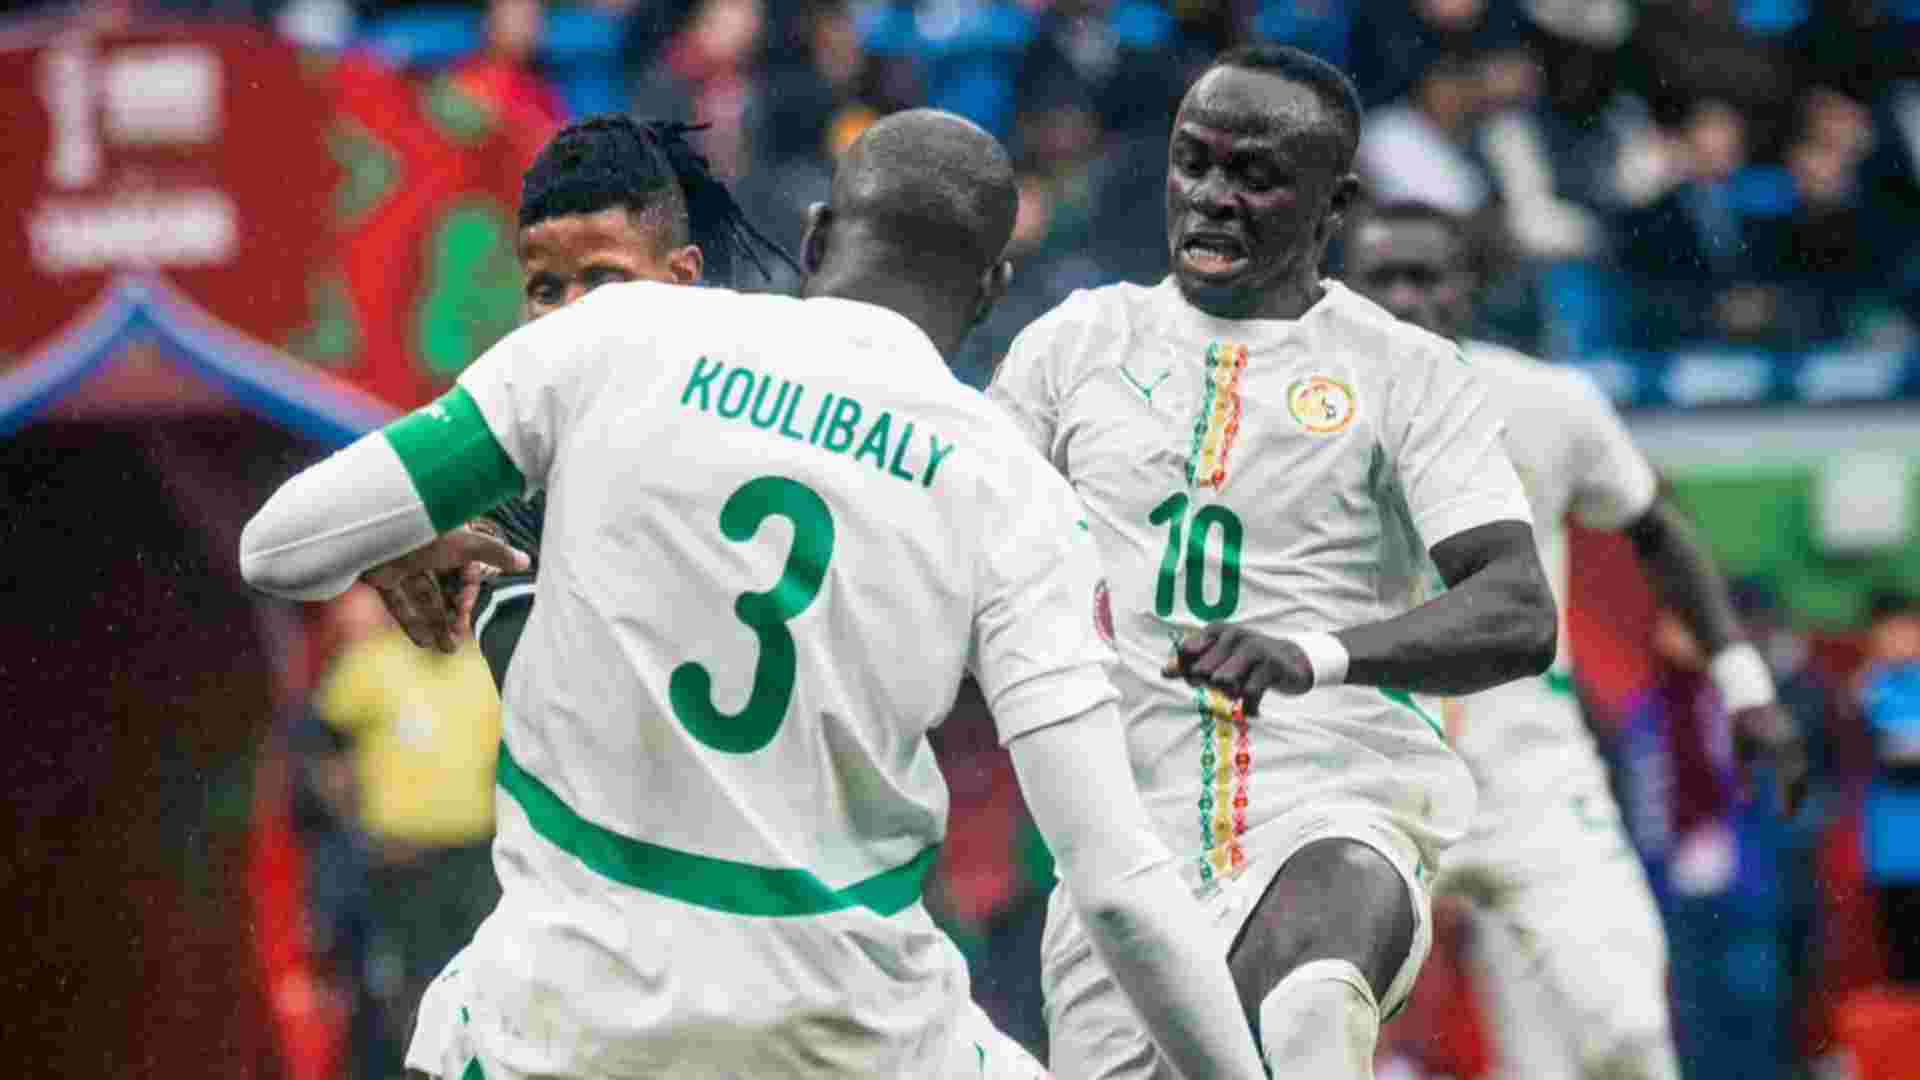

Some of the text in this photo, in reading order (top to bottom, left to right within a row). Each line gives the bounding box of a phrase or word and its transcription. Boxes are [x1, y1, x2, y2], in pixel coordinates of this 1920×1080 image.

[681, 356, 953, 488] KOULIBALY
[669, 475, 835, 755] 3
[1149, 492, 1244, 622] 10
